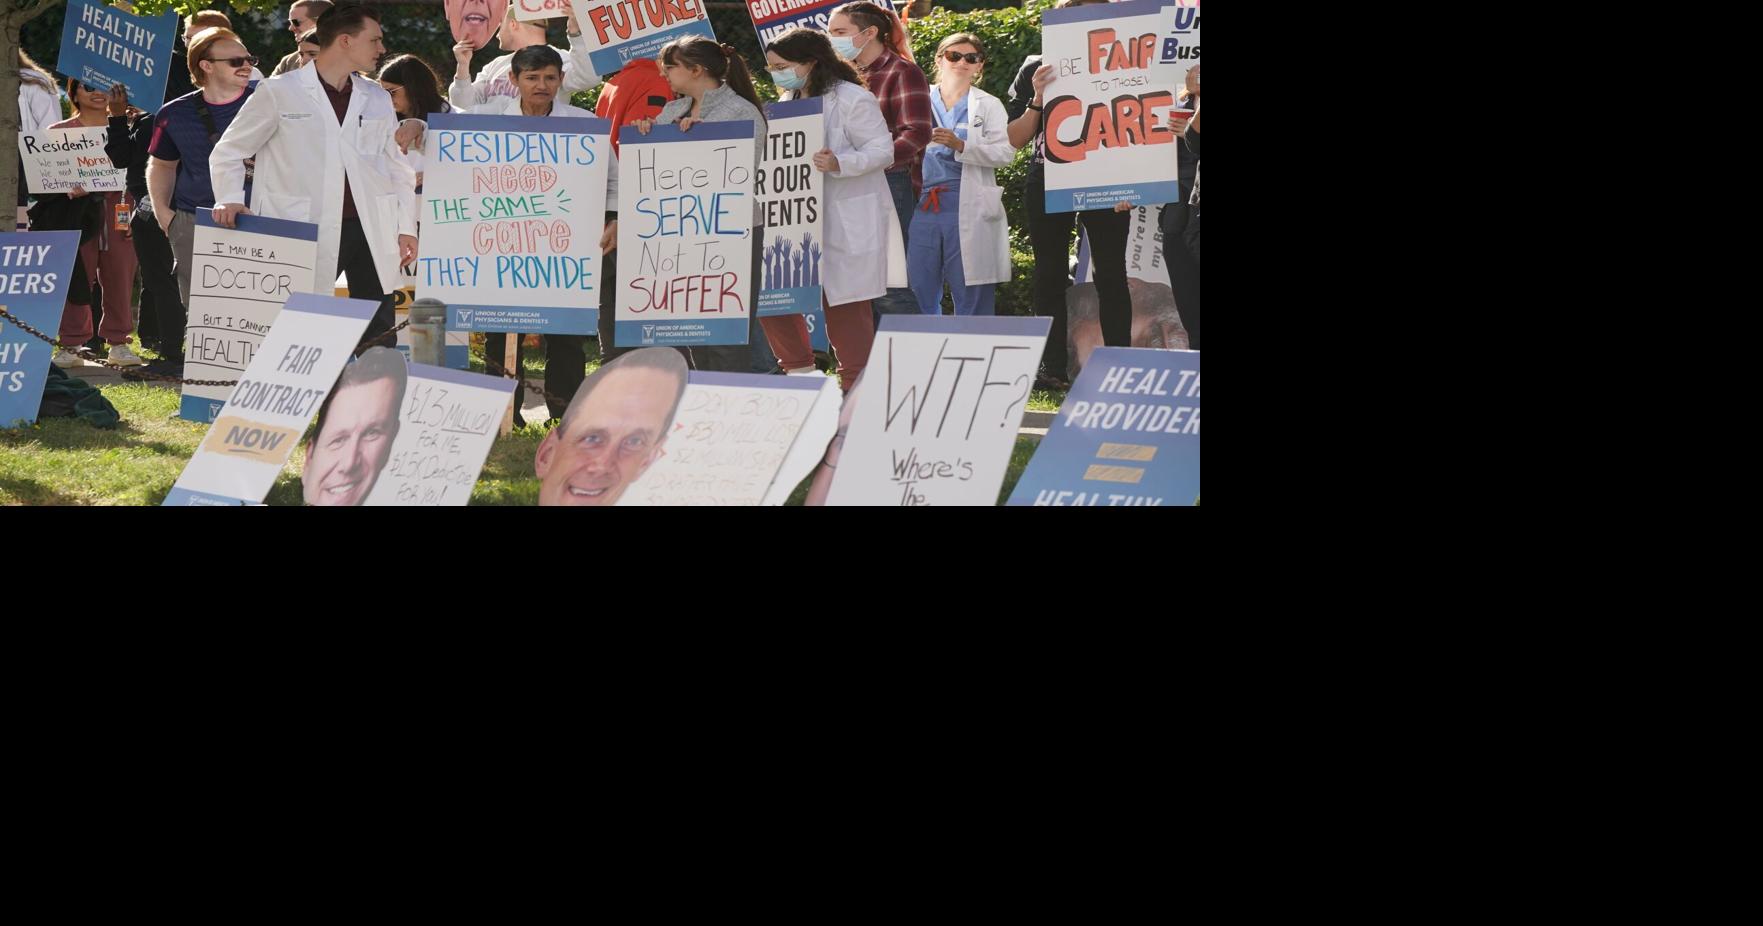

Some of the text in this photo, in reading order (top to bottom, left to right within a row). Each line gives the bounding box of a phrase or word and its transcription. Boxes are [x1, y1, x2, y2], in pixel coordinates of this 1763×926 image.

[751, 0, 821, 19] GOVER
[82, 4, 156, 50] HEALTHY
[75, 27, 154, 76] PATIENTS
[1059, 27, 1157, 77] BE FAIR
[1161, 37, 1200, 60] Bus
[1090, 80, 1109, 91] TO
[1111, 76, 1143, 88] THOSE
[1044, 90, 1174, 164] CARE
[77, 156, 113, 170] Money
[439, 131, 596, 165] RESIDENTS
[90, 178, 118, 190] Fund
[638, 146, 749, 193] Here To
[773, 163, 811, 194] OUR
[428, 194, 548, 221] THE SAME
[636, 192, 750, 239] SERVE,
[212, 242, 276, 260] I MAY BE A
[472, 218, 571, 256] care
[1131, 226, 1145, 271] you're
[419, 255, 593, 291] THEY PROVIDE
[639, 241, 725, 277] Not To
[202, 264, 292, 295] DOCTOR
[629, 271, 744, 313] SUFFER
[203, 314, 272, 333] BUT I CANNOT
[276, 344, 323, 375] FAIR
[884, 337, 1029, 440] WTF?
[1098, 366, 1200, 397] HEALTH
[229, 380, 325, 418] CONTRACT
[1064, 401, 1200, 435] PROVIDER
[224, 425, 288, 451] NOW
[892, 447, 974, 481] Where's
[898, 481, 930, 506] The
